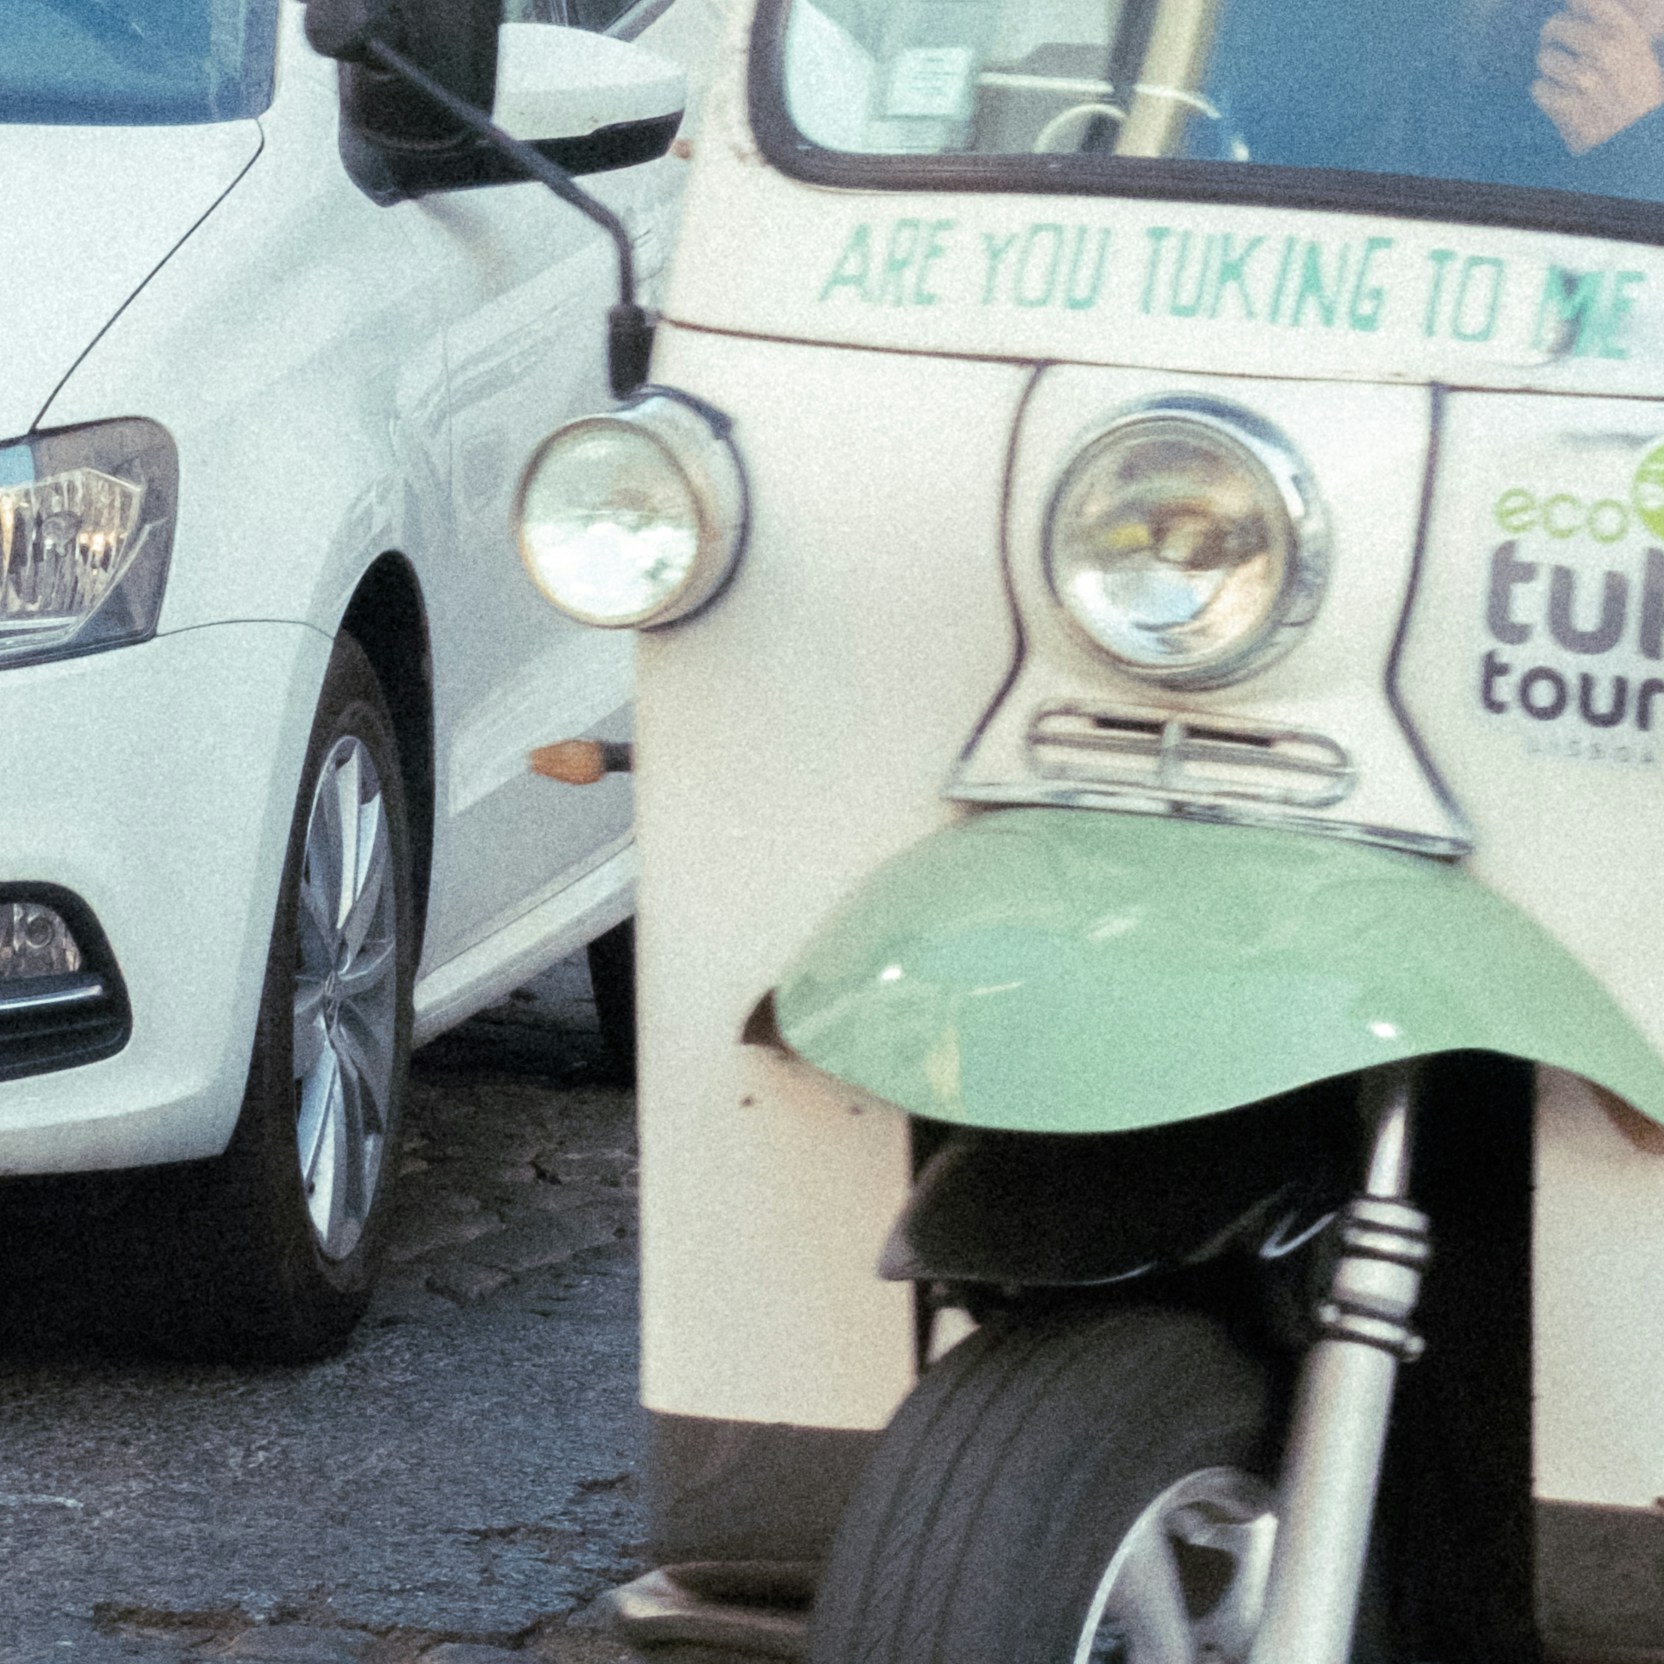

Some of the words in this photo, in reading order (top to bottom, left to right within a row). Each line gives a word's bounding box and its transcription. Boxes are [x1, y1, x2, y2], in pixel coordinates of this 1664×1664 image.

[818, 217, 958, 309] ARE
[981, 222, 1111, 311] YOU
[1138, 226, 1395, 333] TUKING
[1422, 248, 1505, 342] TO
[1497, 487, 1631, 544] eco
